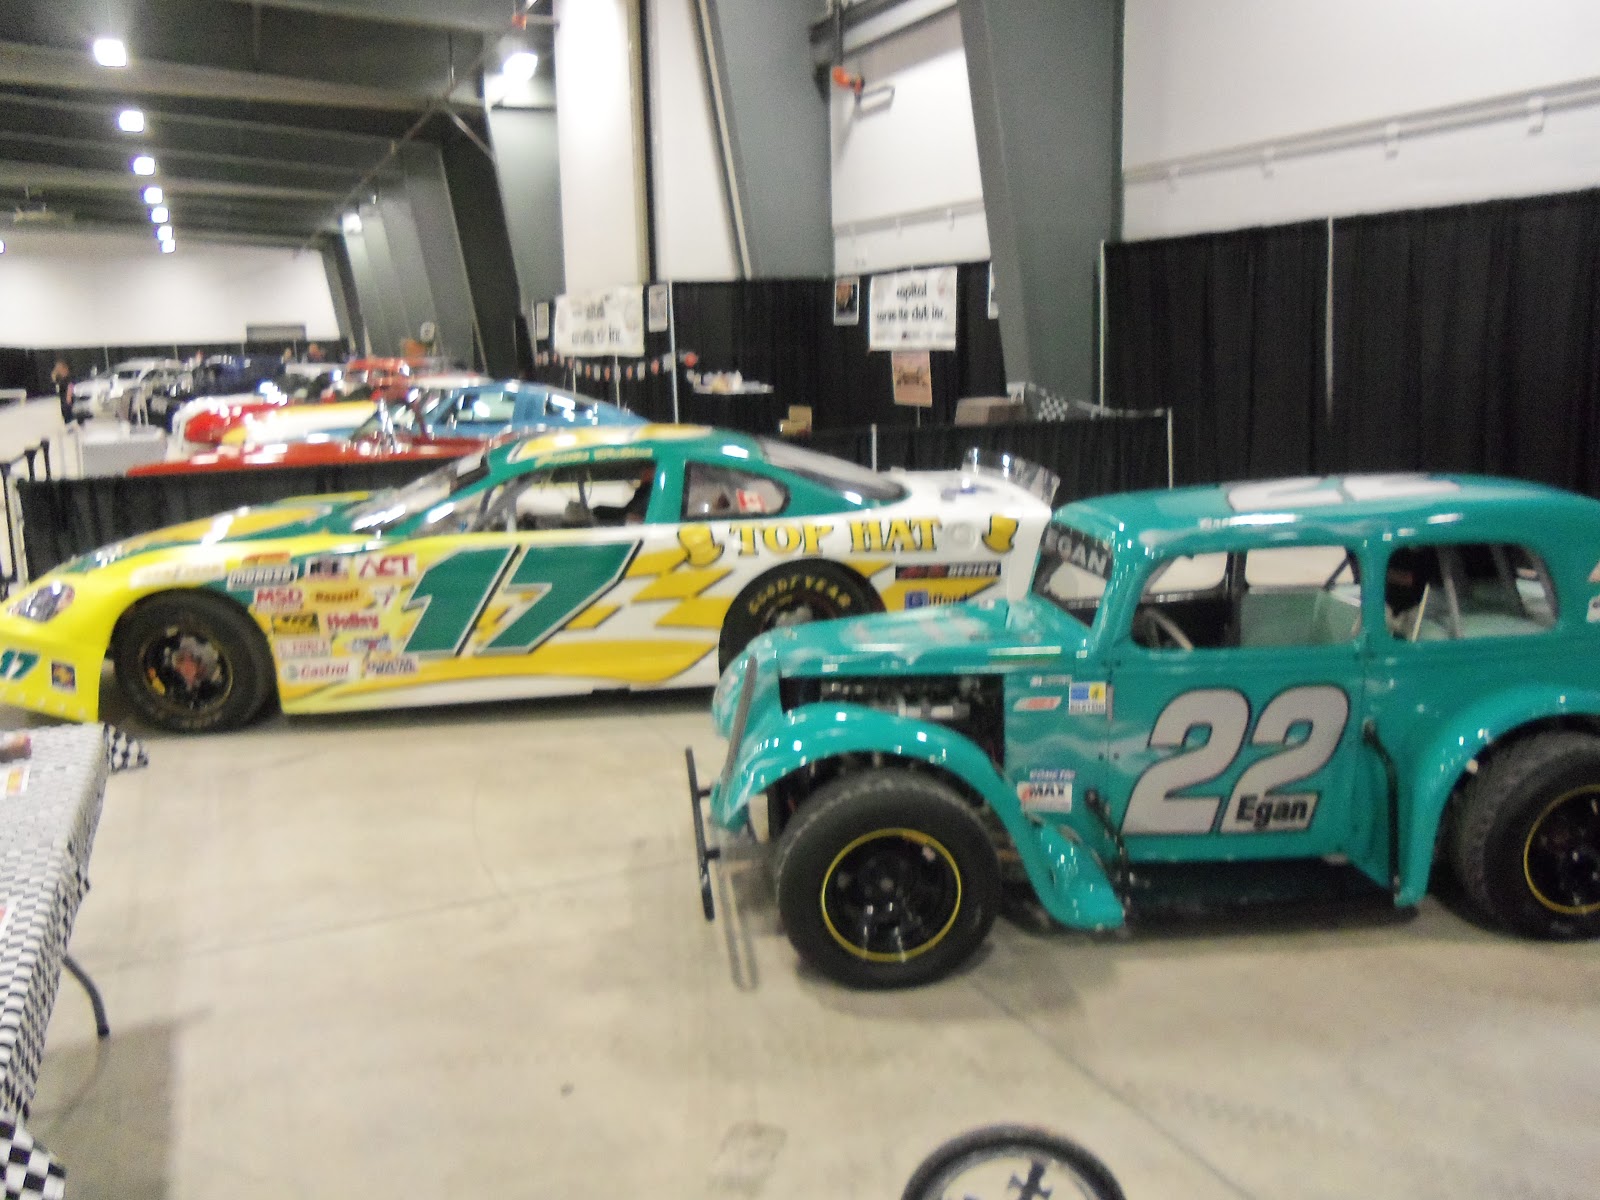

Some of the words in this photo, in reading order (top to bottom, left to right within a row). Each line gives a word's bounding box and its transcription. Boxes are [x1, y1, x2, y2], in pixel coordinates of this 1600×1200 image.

[729, 524, 834, 557] TOP
[848, 517, 942, 552] HAT
[359, 556, 410, 577] ACT
[402, 542, 641, 656] 17
[1121, 686, 1348, 835] 22
[1236, 797, 1309, 829] Egan
